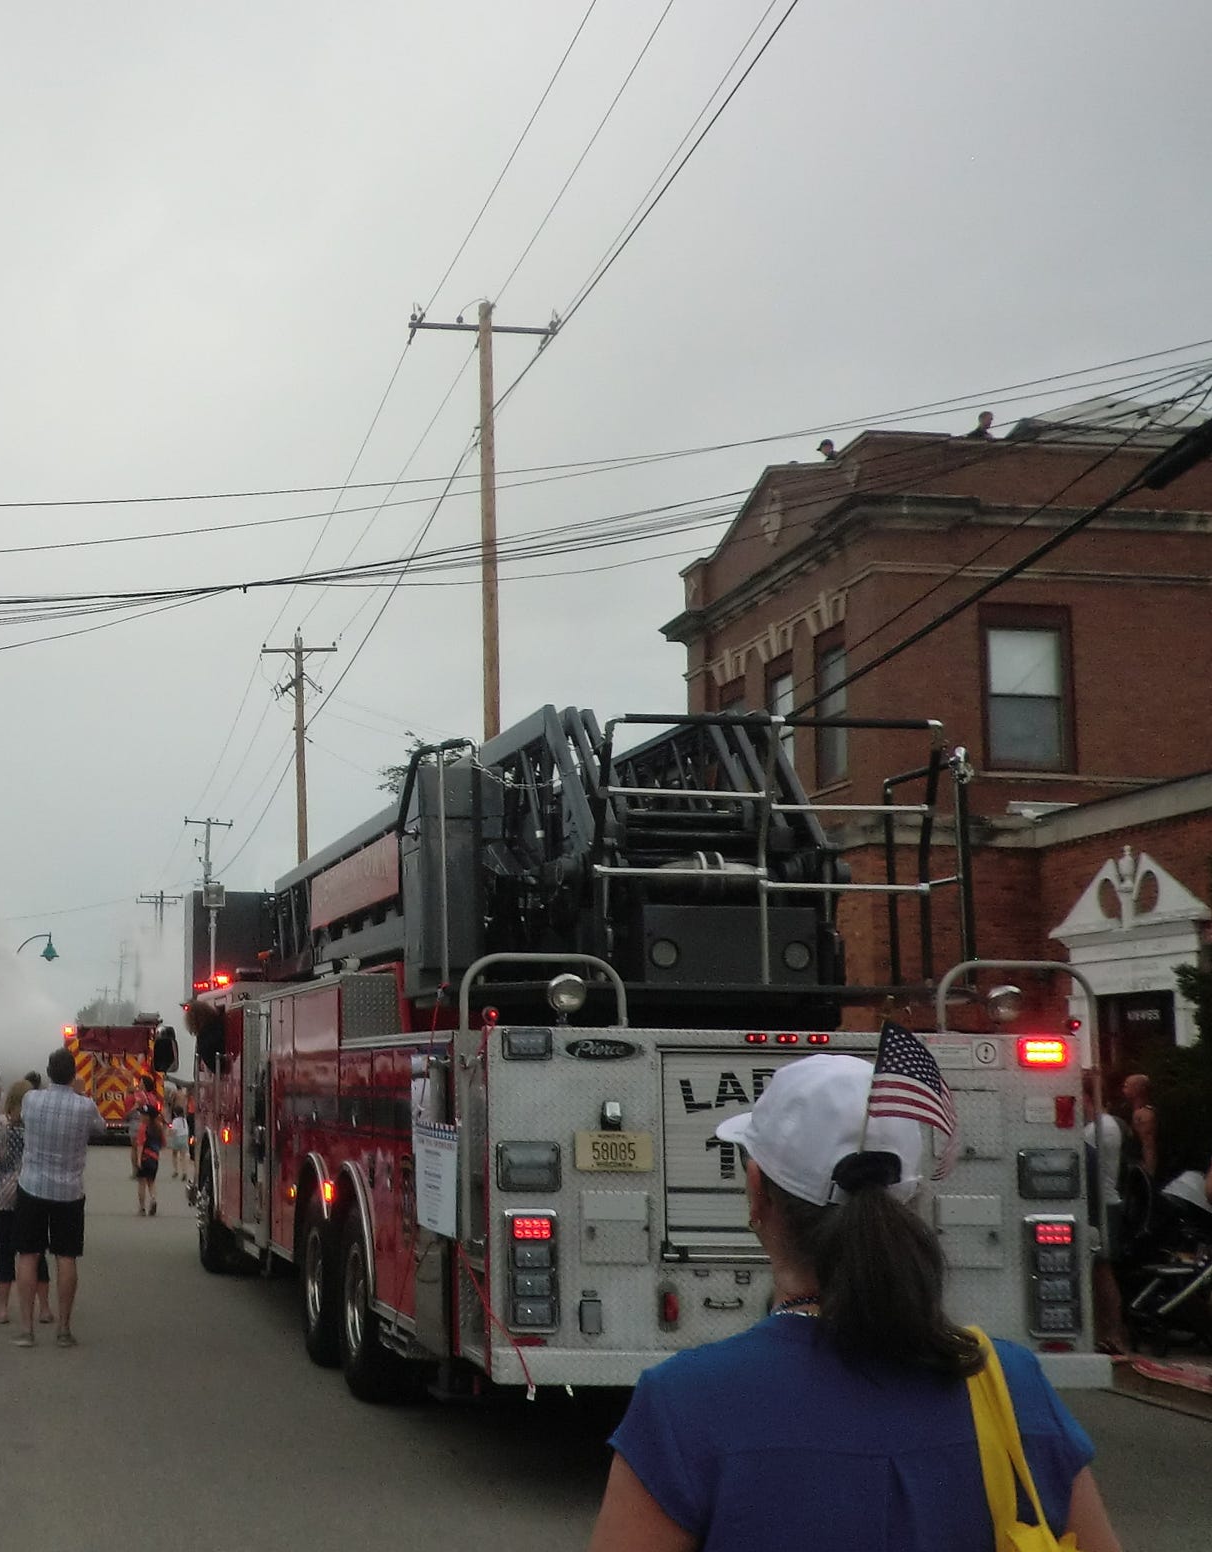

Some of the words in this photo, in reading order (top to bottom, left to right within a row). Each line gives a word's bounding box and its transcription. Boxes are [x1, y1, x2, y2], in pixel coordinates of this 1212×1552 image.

[575, 1040, 628, 1058] Pierce
[679, 1068, 777, 1114] LAD
[592, 1142, 636, 1161] 58085
